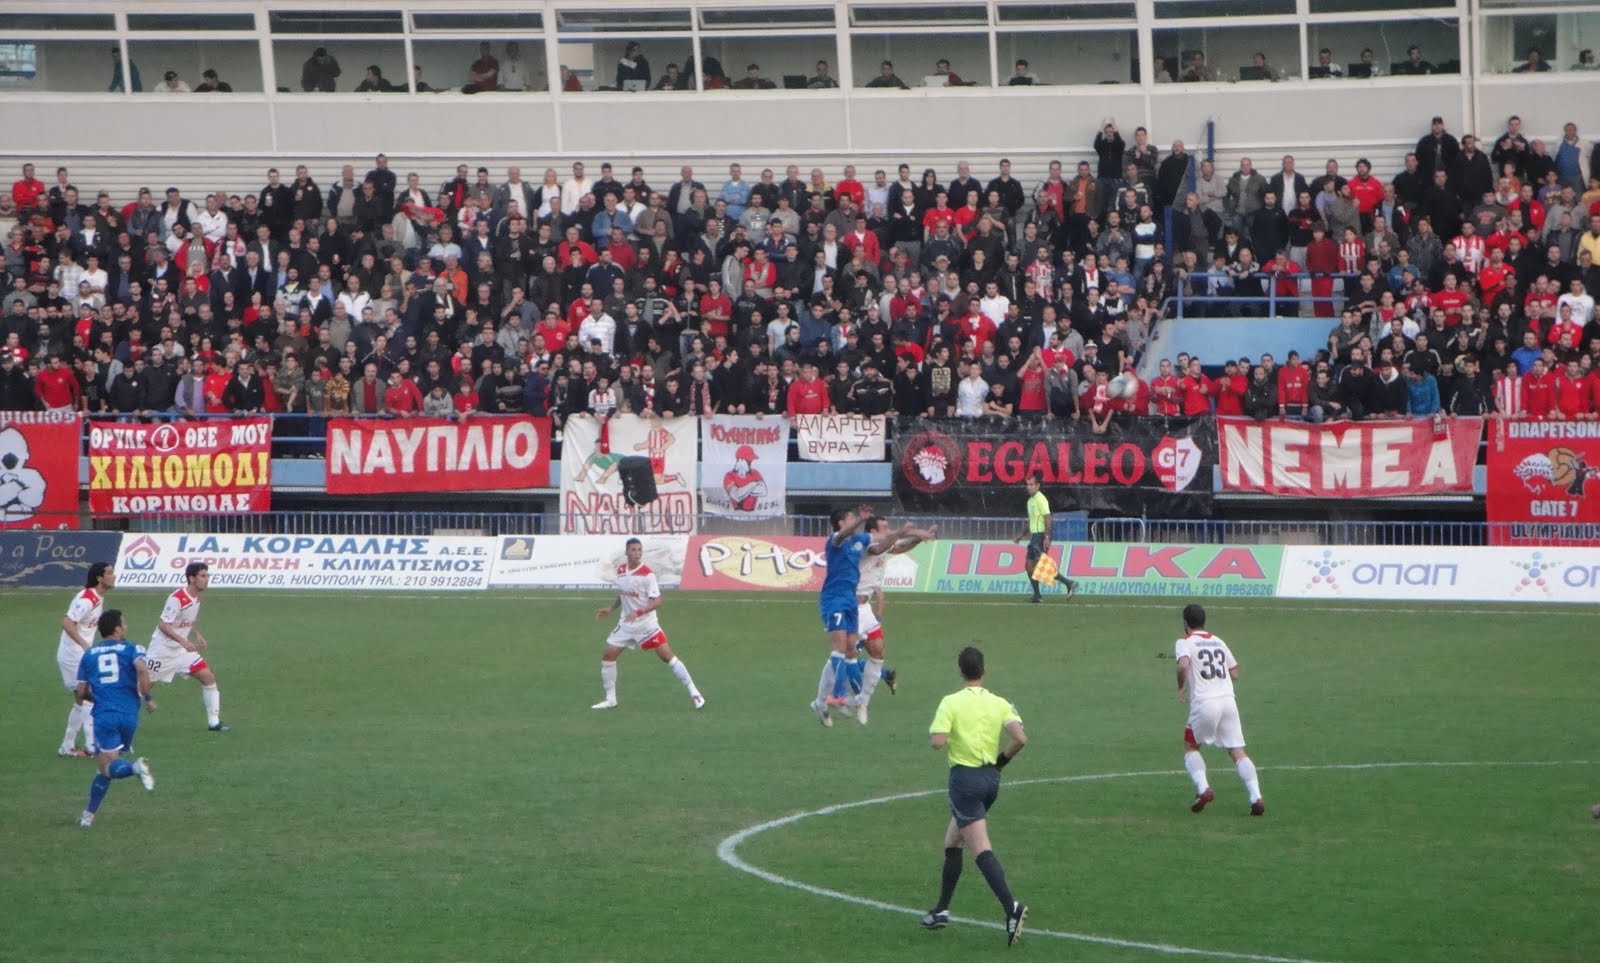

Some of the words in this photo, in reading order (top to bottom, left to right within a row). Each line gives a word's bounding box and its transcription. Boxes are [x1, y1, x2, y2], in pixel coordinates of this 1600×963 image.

[90, 427, 146, 449] ΘΡΥΛΕ
[161, 429, 169, 448] 7
[185, 427, 218, 447] ΘΕΕ
[230, 424, 268, 445] ΜΟΥ
[853, 433, 870, 454] 7
[330, 421, 539, 475] ΝΑΥΠΛΙΟ
[1158, 447, 1190, 468] G7
[1223, 425, 1458, 489] ΝΕΜΕΑ
[90, 451, 269, 490] ΧΙΛΙΟΜΟΔΙ
[966, 441, 1146, 485] EGALEO
[112, 494, 249, 513] ΚΟΡΙΝΘΙΑΣ
[1530, 500, 1566, 517] GATE
[1569, 500, 1578, 517] 7
[35, 535, 86, 558] Poco
[242, 537, 430, 555] ΚΟΡΔΑΛΗΣ
[322, 558, 485, 572] ΚΛΙΜΑΤΙΣΜΟΣ
[118, 572, 170, 584] ΗΡΩΩΝ
[171, 572, 266, 585] ΠΟΕΧΝΕΙΟΥ
[267, 575, 286, 586] 38,
[290, 575, 365, 587] ΗΛΙΟΥΠΟΛΗ
[403, 577, 427, 587] 210
[430, 577, 483, 587] 9912884
[884, 577, 913, 587] IDILKA
[1100, 582, 1167, 595] ΗΛΙΟΥΠΟΛΗ
[1202, 584, 1222, 596] 210
[834, 613, 842, 626] 7
[98, 653, 120, 684] 9
[147, 659, 161, 673] 92
[1198, 649, 1226, 680] 33
